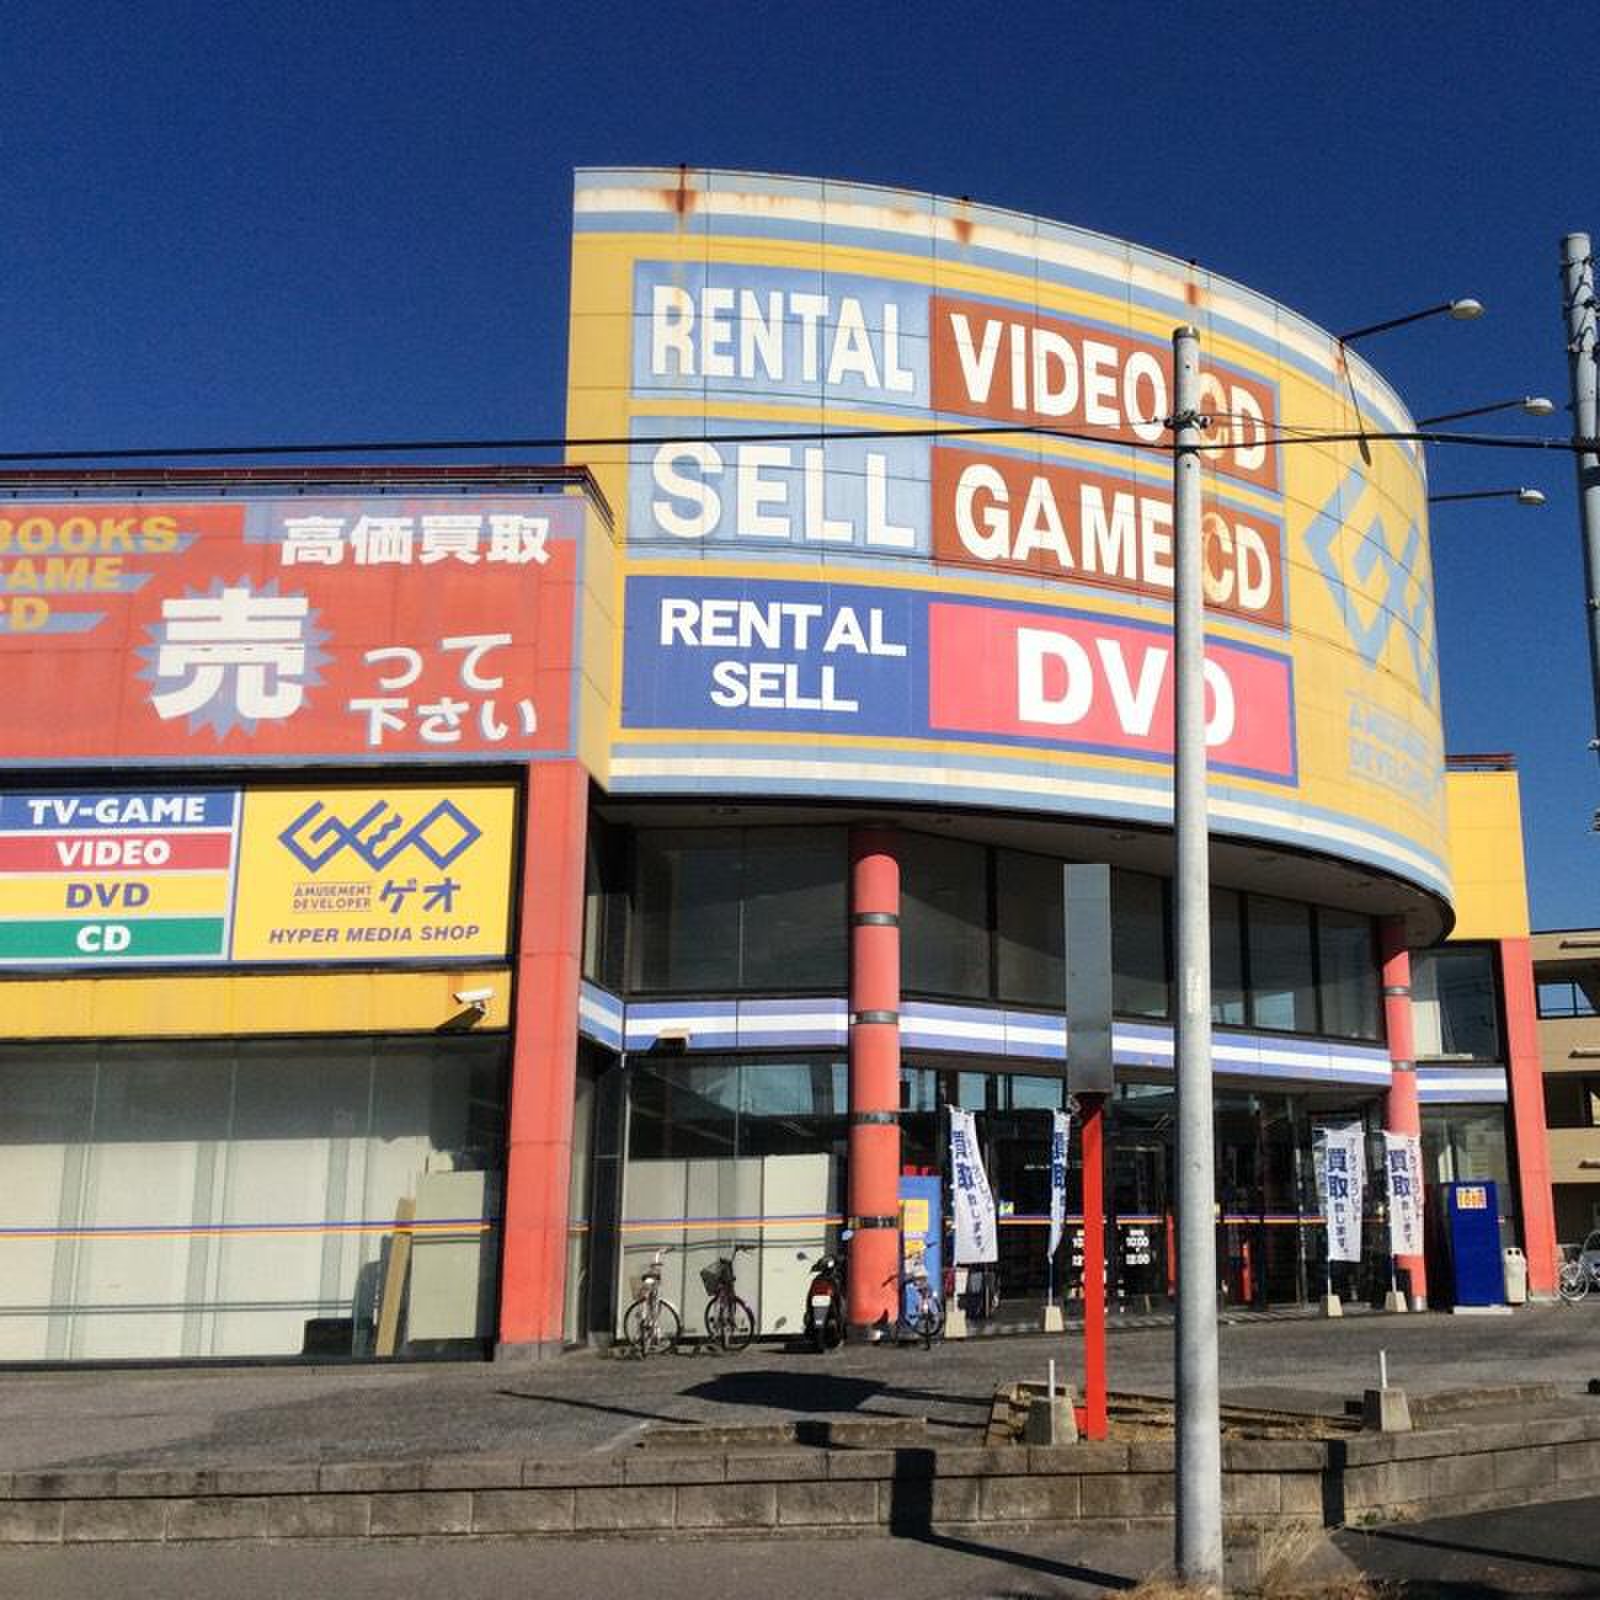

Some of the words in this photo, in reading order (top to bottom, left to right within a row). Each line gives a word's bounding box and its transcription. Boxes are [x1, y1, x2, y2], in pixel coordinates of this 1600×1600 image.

[652, 285, 914, 393] RENTAL
[950, 314, 1167, 441] VIDEO
[1199, 372, 1267, 471] CD
[652, 441, 916, 548] SELL
[281, 515, 551, 566] 高価買取
[955, 464, 1174, 588] GAME
[1202, 512, 1271, 609] CD
[0, 557, 123, 590] AME
[0, 597, 49, 631] D
[659, 598, 906, 657] RENTAL
[150, 587, 309, 721] 売
[363, 633, 512, 690] って
[710, 661, 858, 712] SELL
[349, 697, 538, 745] 下さい
[28, 797, 206, 825] TV-GAME
[55, 839, 171, 866] VIDEO
[65, 883, 150, 908] DVD
[293, 898, 371, 910] DEVELOPER
[294, 885, 372, 897] AMUSEMENT
[379, 877, 461, 913] ゲオ
[76, 925, 131, 951] CD
[269, 928, 339, 944] HYPER
[346, 927, 413, 942] MEDIA
[420, 925, 480, 941] SHOP
